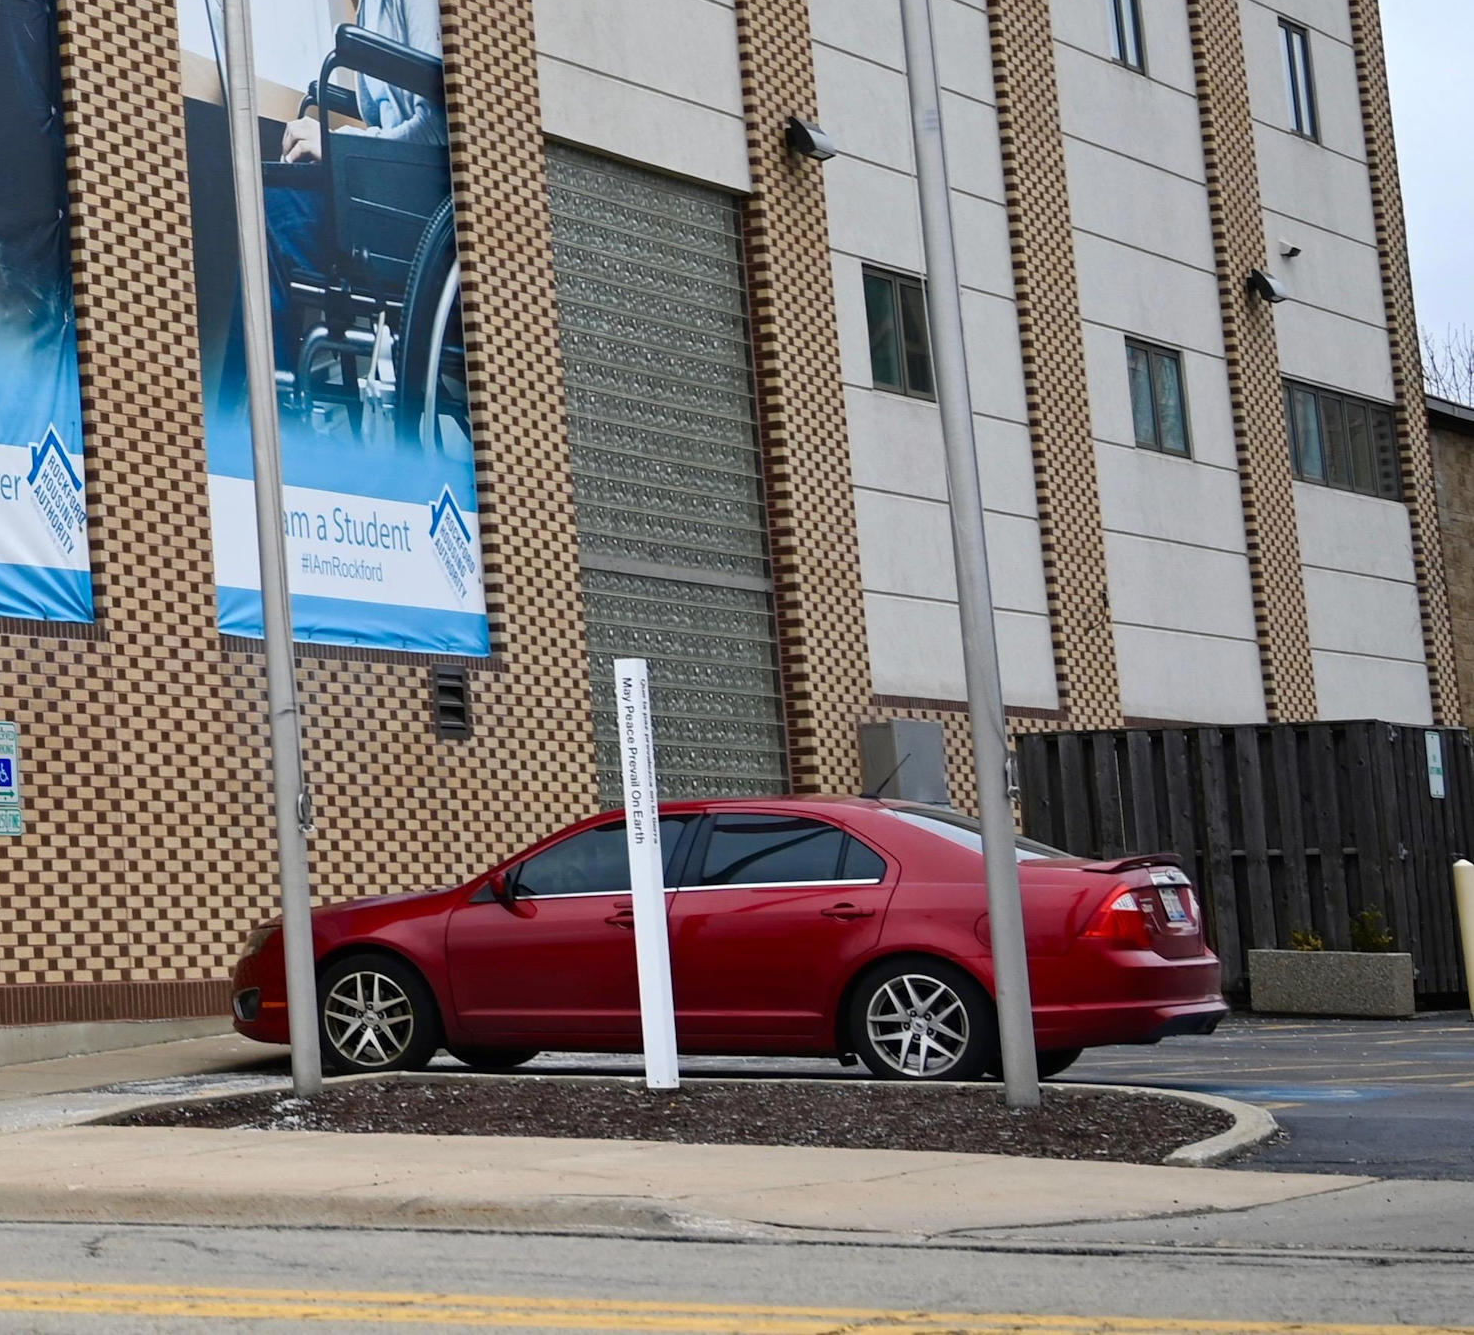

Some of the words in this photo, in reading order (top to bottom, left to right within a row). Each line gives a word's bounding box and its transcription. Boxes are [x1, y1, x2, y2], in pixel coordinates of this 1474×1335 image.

[41, 469, 74, 531] HOUSING
[48, 454, 87, 528] ROCKFORD
[33, 486, 75, 555] AUTHORITY
[317, 514, 328, 541] a
[333, 507, 411, 552] Student
[444, 512, 475, 574] ROCKFORD
[301, 553, 383, 582] #IAmRockford
[434, 538, 468, 599] AUTHORITY
[440, 525, 466, 578] HOUSING
[621, 677, 633, 702] May
[625, 706, 635, 744] Peace
[628, 747, 641, 787] Prevail
[631, 790, 642, 807] On
[633, 810, 645, 844] Earth
